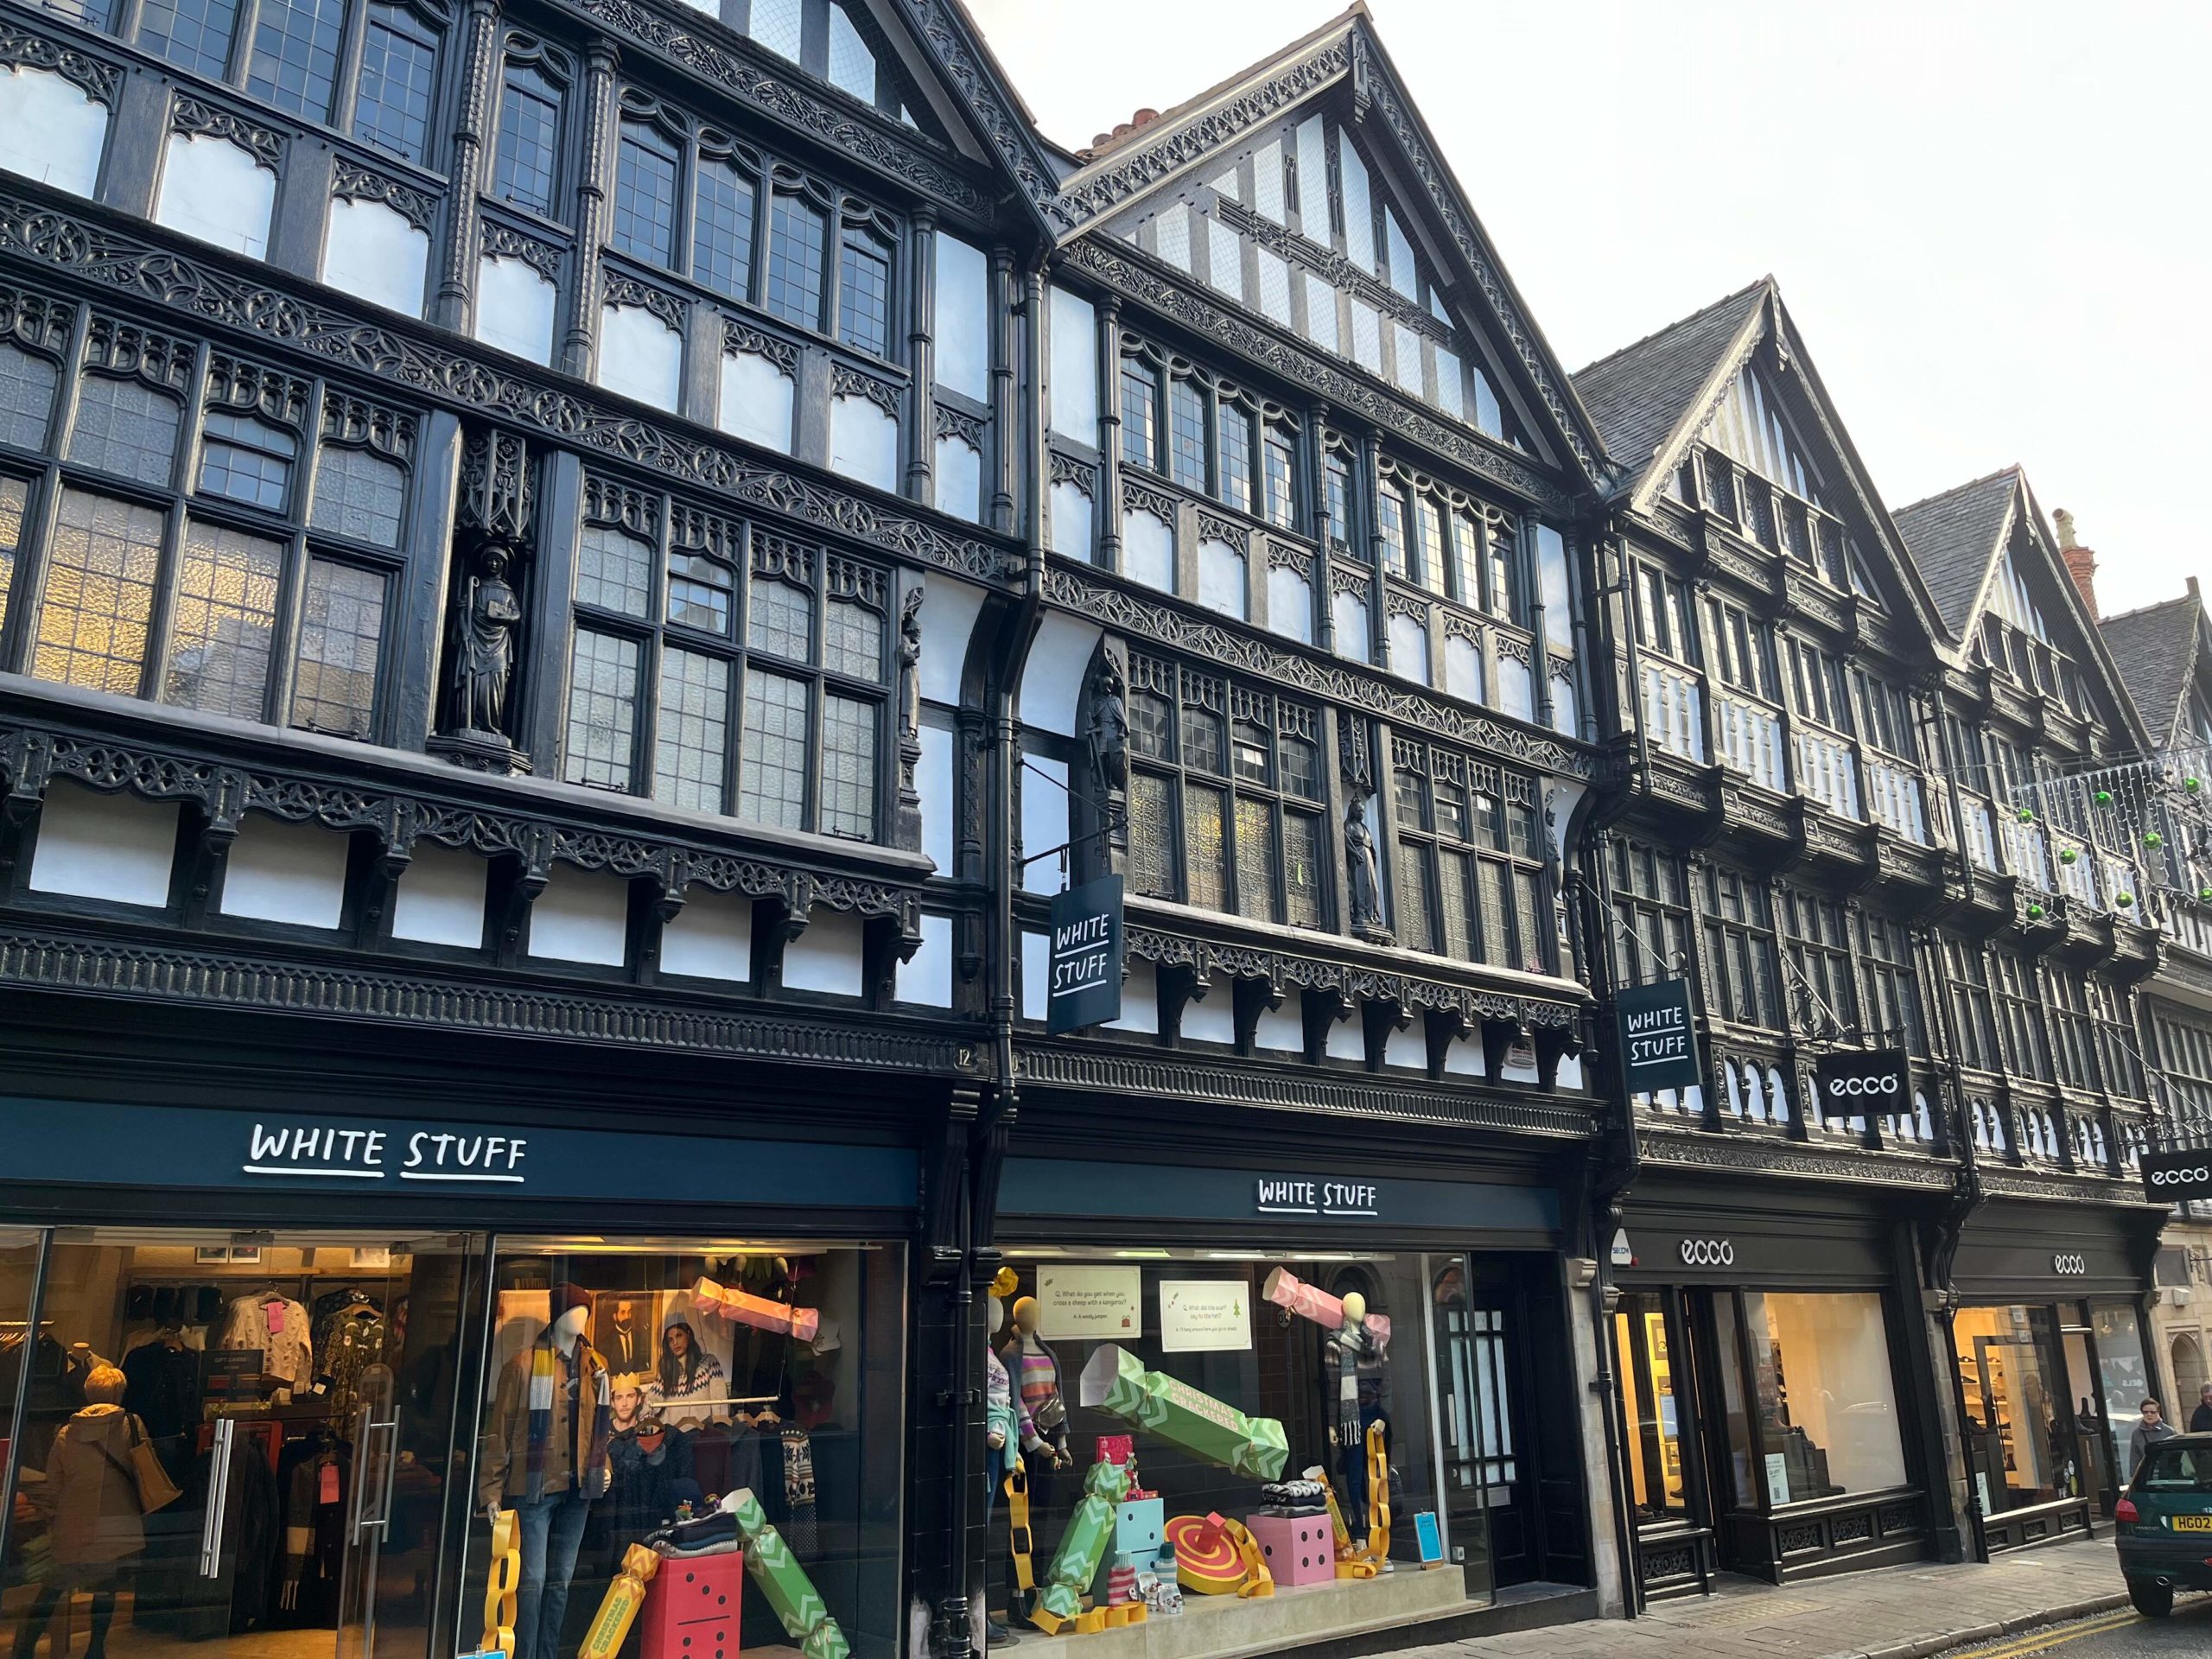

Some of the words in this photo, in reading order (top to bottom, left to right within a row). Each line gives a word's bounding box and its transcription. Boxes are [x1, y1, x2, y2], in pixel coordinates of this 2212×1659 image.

[1057, 913, 1109, 950] WHITE
[1053, 953, 1107, 988] STUFF
[1627, 1007, 1683, 1032] WHITE
[959, 1049, 970, 1065] 12
[1631, 1036, 1686, 1060] STUFF
[1012, 1054, 1019, 1071] 0
[1829, 1073, 1898, 1096] ecco
[251, 1124, 386, 1165] WHITE
[404, 1132, 527, 1169] STUFF
[2151, 1166, 2209, 1185] ecco
[1259, 1179, 1315, 1205] WHITE
[1323, 1183, 1376, 1207] STUFF
[1681, 1238, 1733, 1265] ecco
[2055, 1253, 2085, 1274] ecco
[1168, 1379, 1235, 1418] CHRISTMAS
[1172, 1392, 1238, 1431] CRACKERED
[2178, 1517, 2210, 1529] HG02
[593, 1597, 622, 1649] CHRISTMAS
[599, 1599, 629, 1653] CRACKERED
